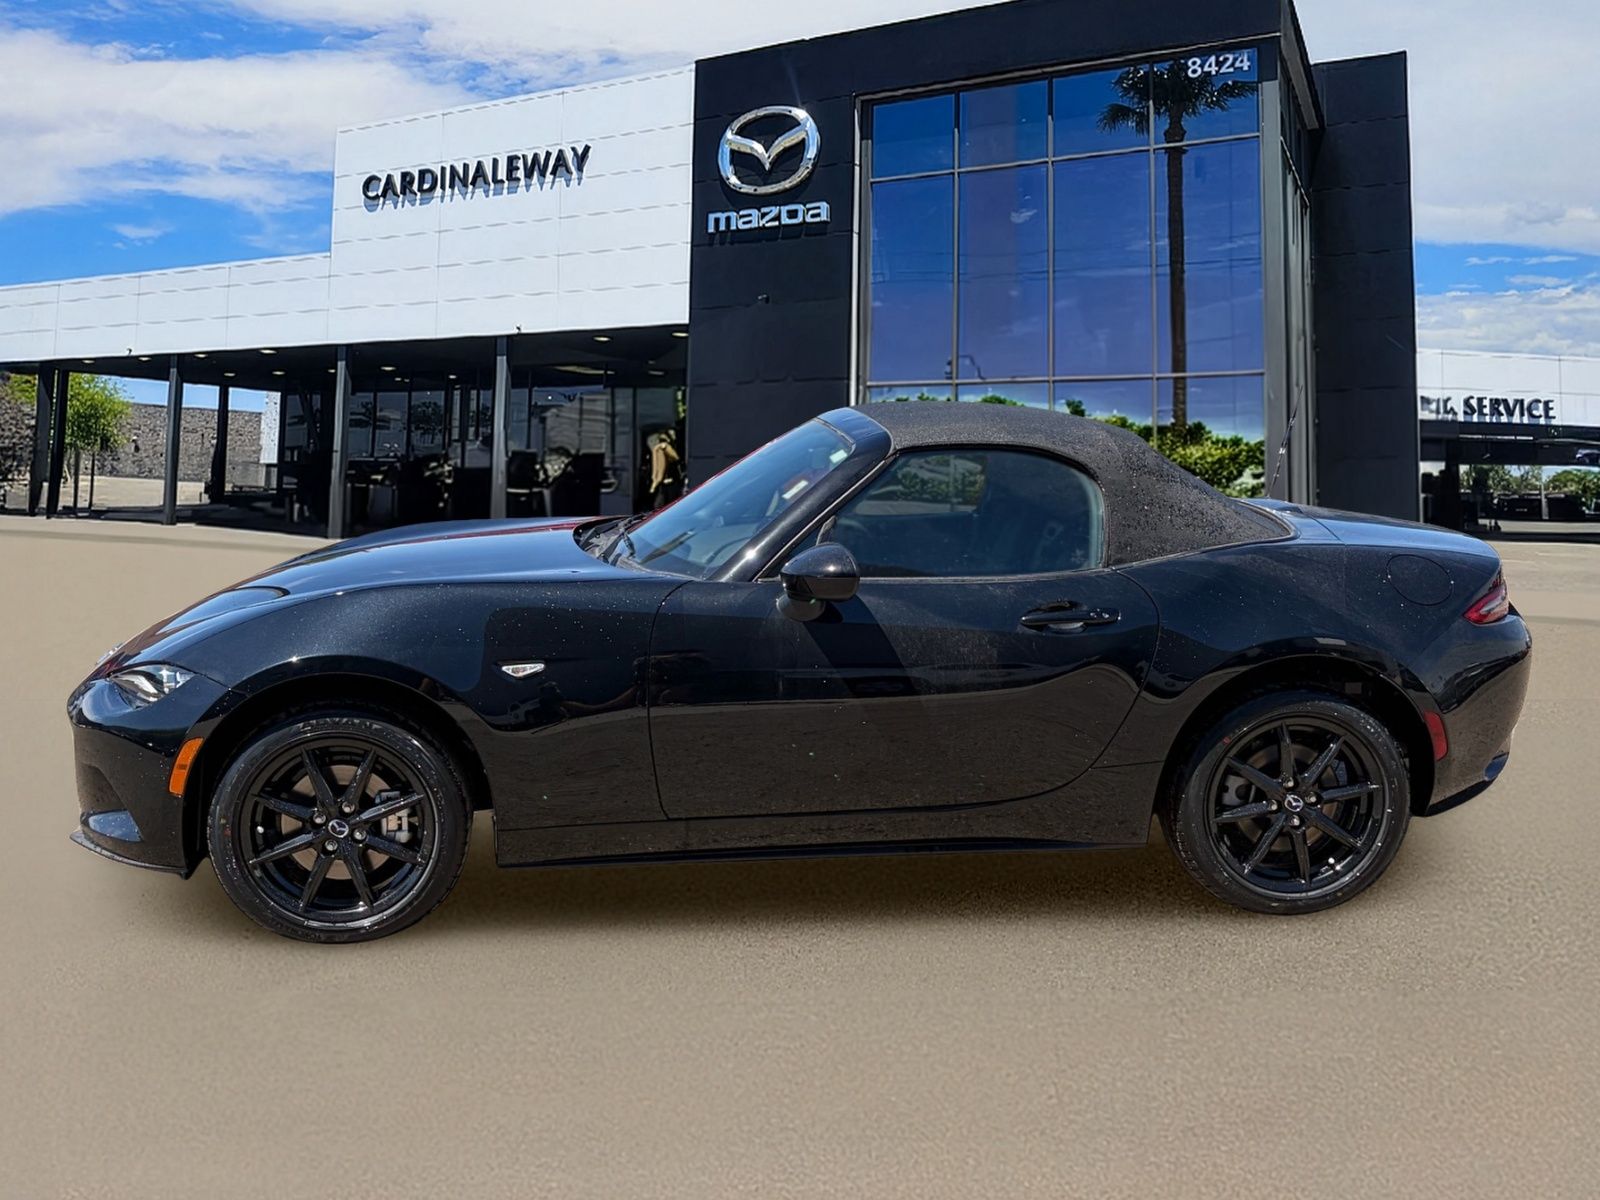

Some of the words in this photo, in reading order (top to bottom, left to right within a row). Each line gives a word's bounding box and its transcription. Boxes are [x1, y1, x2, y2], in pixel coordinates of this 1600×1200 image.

[1187, 52, 1251, 78] 8424
[362, 144, 592, 201] CARDINALEWAY
[707, 201, 830, 233] mazda
[1462, 395, 1556, 420] SERVICE
